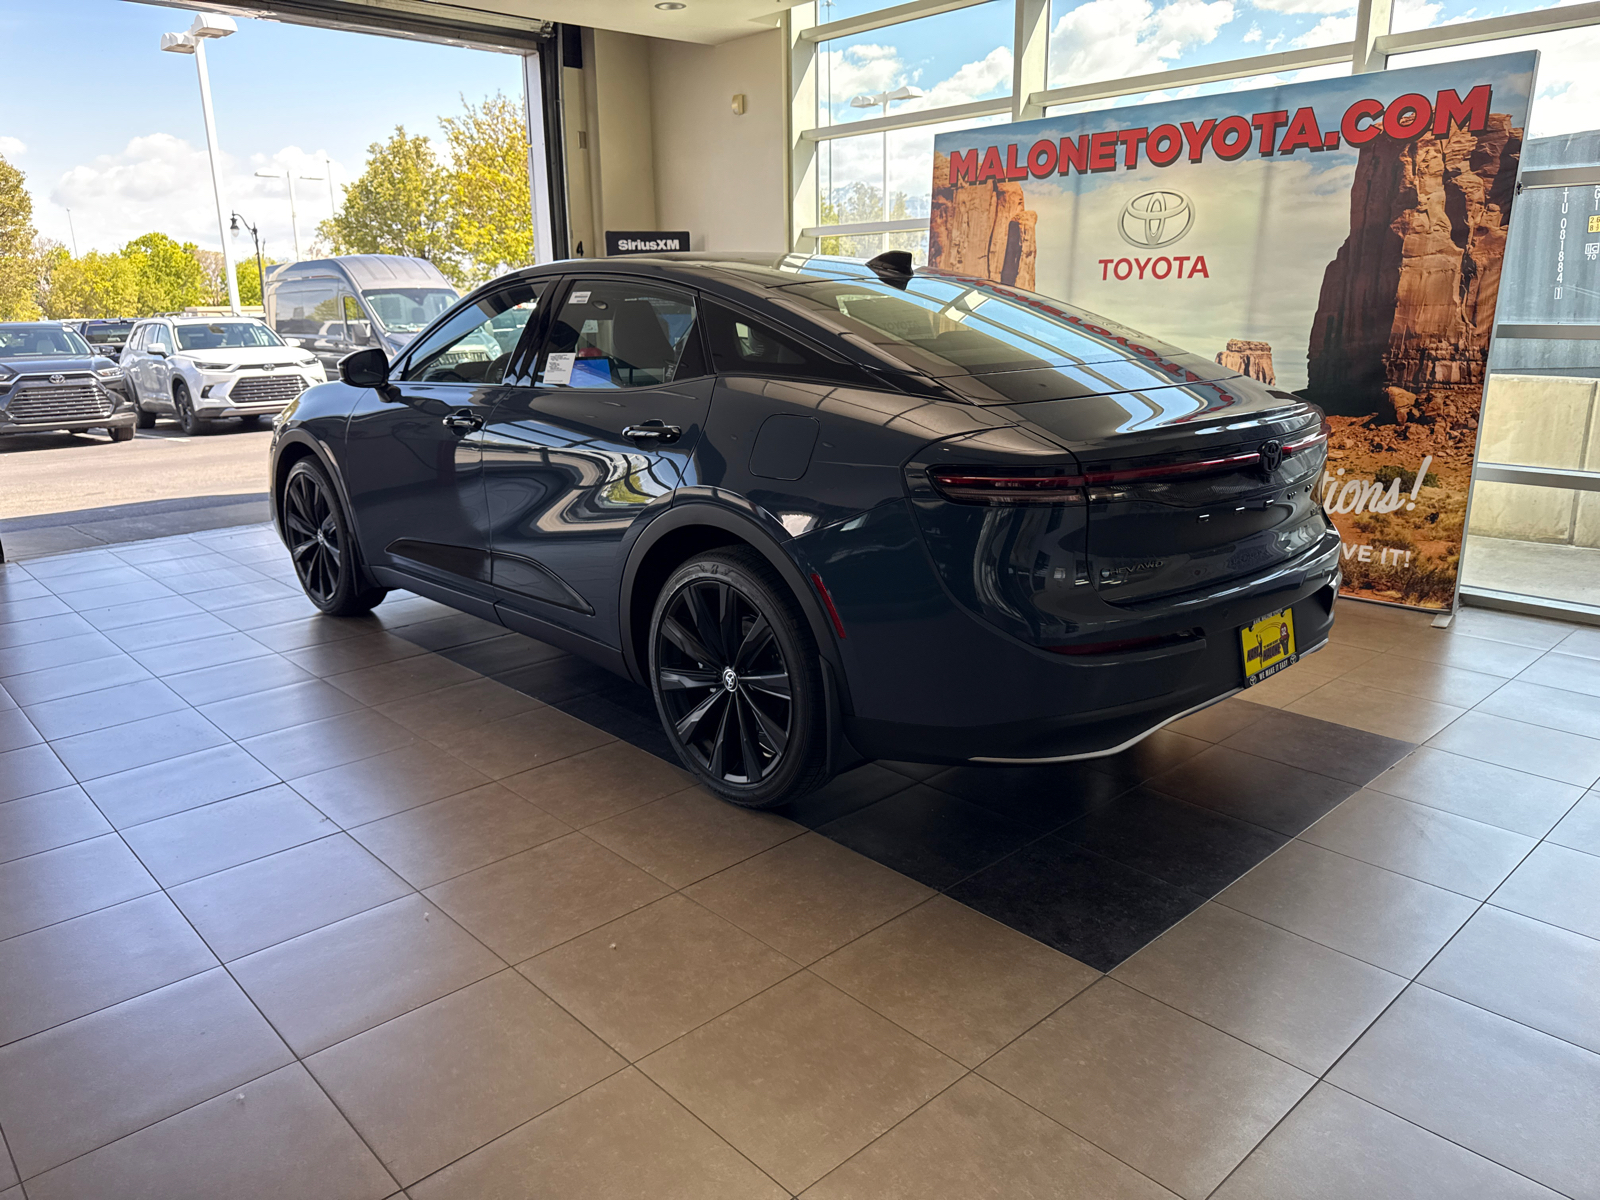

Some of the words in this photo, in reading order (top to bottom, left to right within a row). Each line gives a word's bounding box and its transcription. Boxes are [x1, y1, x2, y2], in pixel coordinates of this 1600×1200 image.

[950, 84, 1493, 186] MALONETOYOTA.COM
[576, 241, 584, 257] 4
[618, 239, 680, 251] SiriusXM
[1556, 218, 1567, 284] 081884
[1099, 256, 1210, 281] TOYOTA
[1381, 547, 1411, 568] IT!
